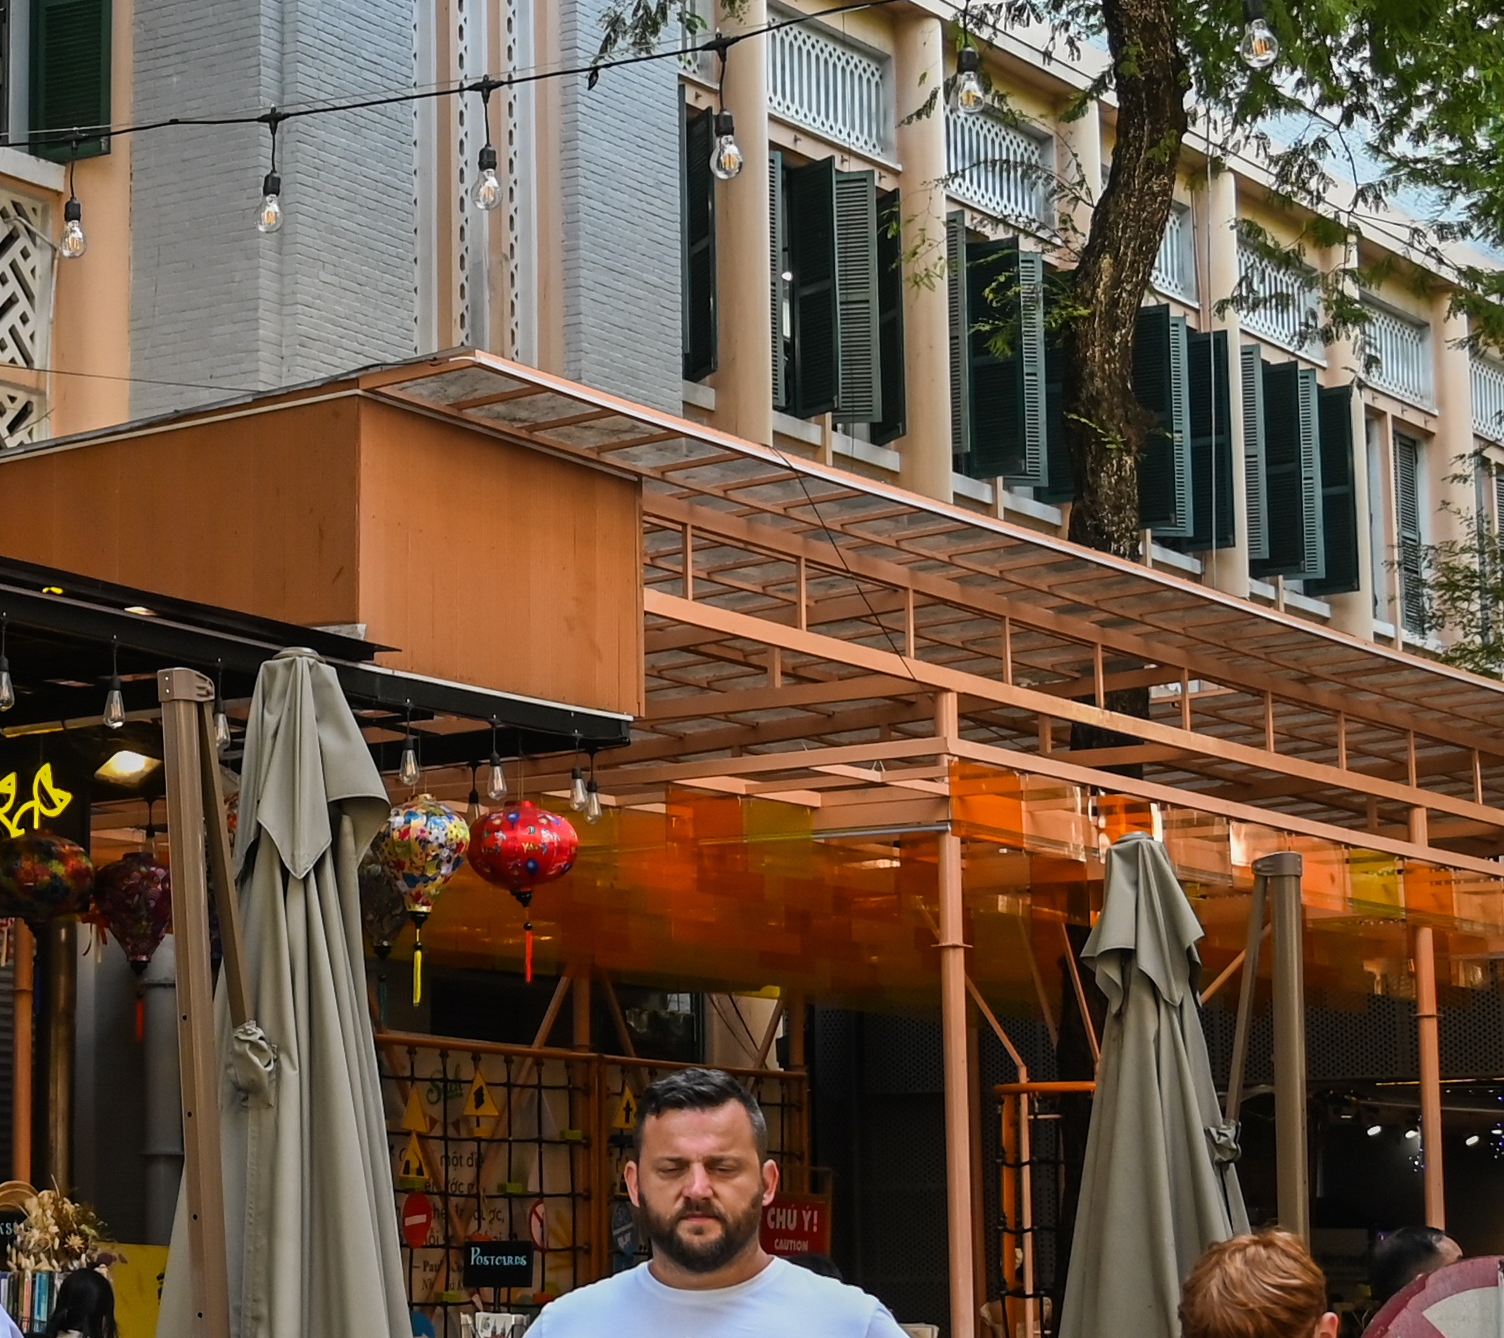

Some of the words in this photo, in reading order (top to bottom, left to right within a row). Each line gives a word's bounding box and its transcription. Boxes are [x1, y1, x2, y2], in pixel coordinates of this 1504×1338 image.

[766, 1204, 798, 1231] CHÚ
[801, 1204, 819, 1232] Ý!
[774, 1238, 809, 1252] CAUTION
